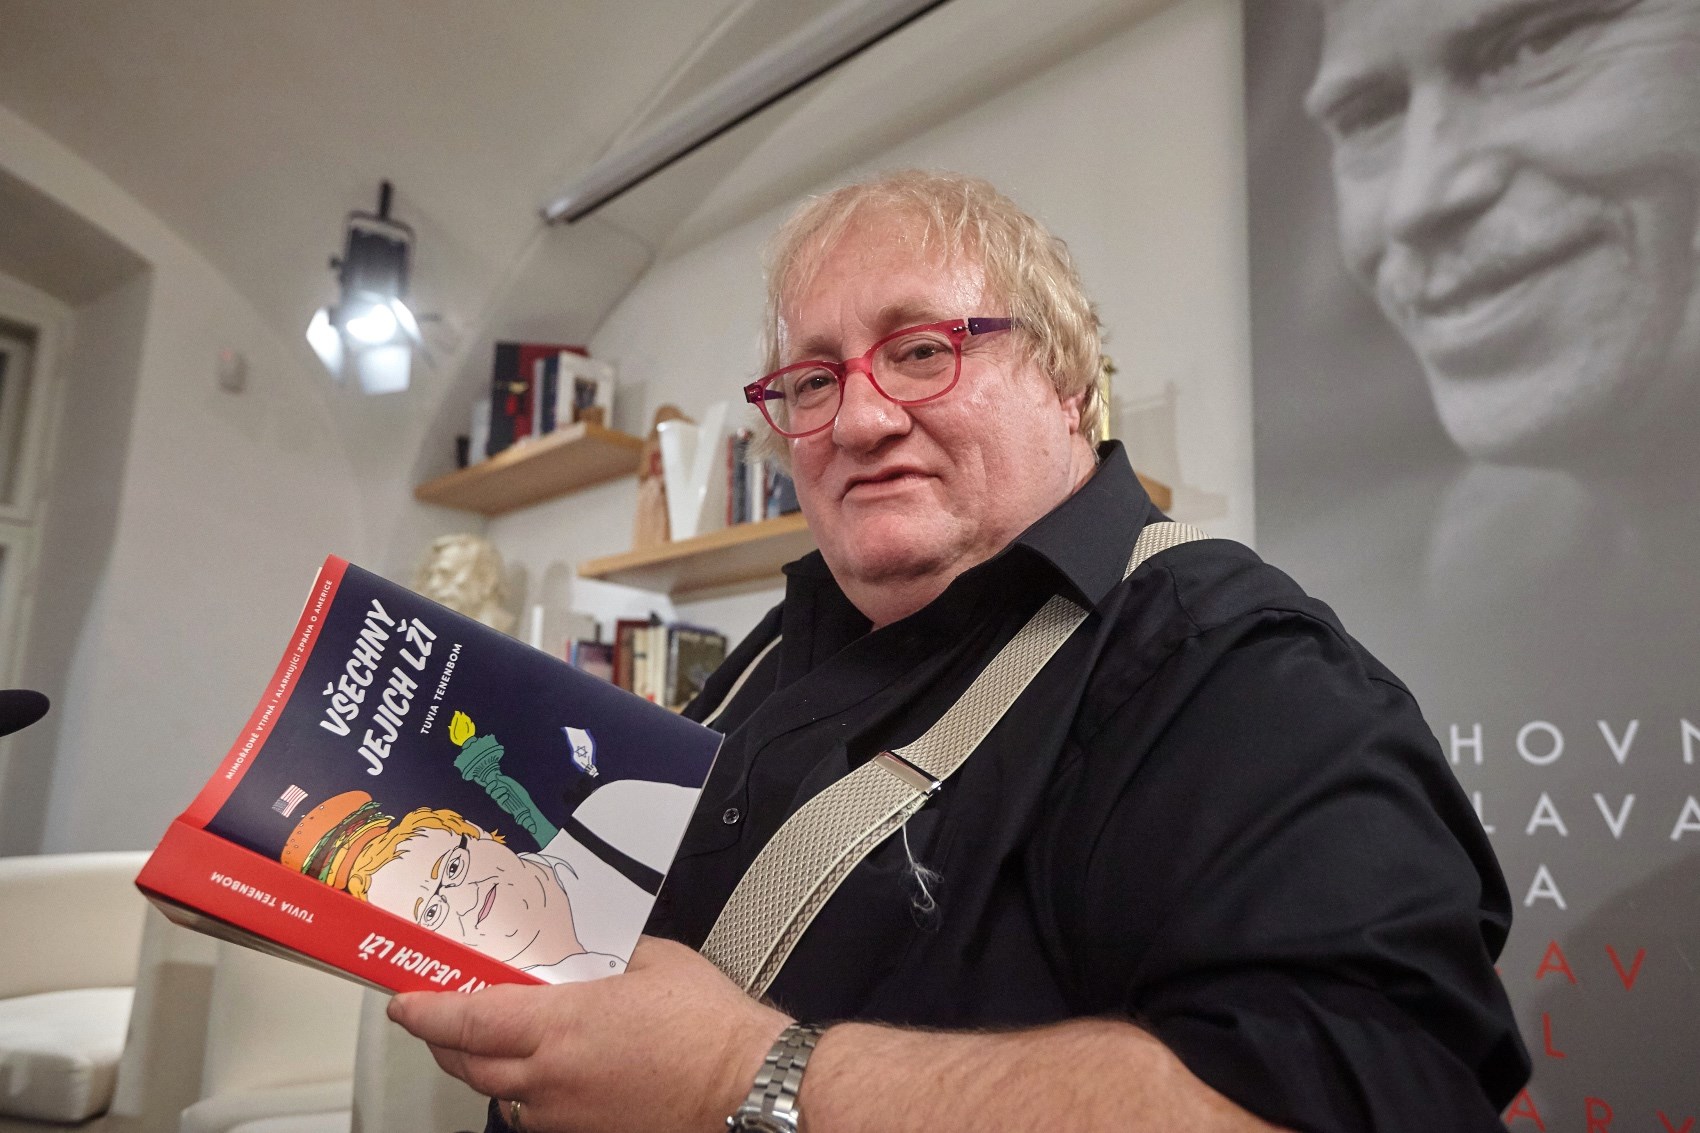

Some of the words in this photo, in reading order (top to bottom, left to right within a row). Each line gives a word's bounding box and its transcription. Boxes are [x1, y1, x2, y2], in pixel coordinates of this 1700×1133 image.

[225, 732, 260, 780] MIMOŘÁDNĚ
[255, 704, 276, 732] VTIPNÁ
[276, 653, 301, 699] ALARMUJÍCÍ
[297, 624, 315, 653] ZPRÁVA
[315, 579, 333, 615] AMERICE
[319, 598, 396, 737] VŠECHNY
[420, 704, 439, 734] TUVIA
[433, 643, 463, 702] TENENBOM
[357, 666, 419, 776] JEJICH
[210, 871, 276, 908] TENENBOM
[280, 900, 315, 924] TUVIA
[392, 944, 462, 985] JEJICH
